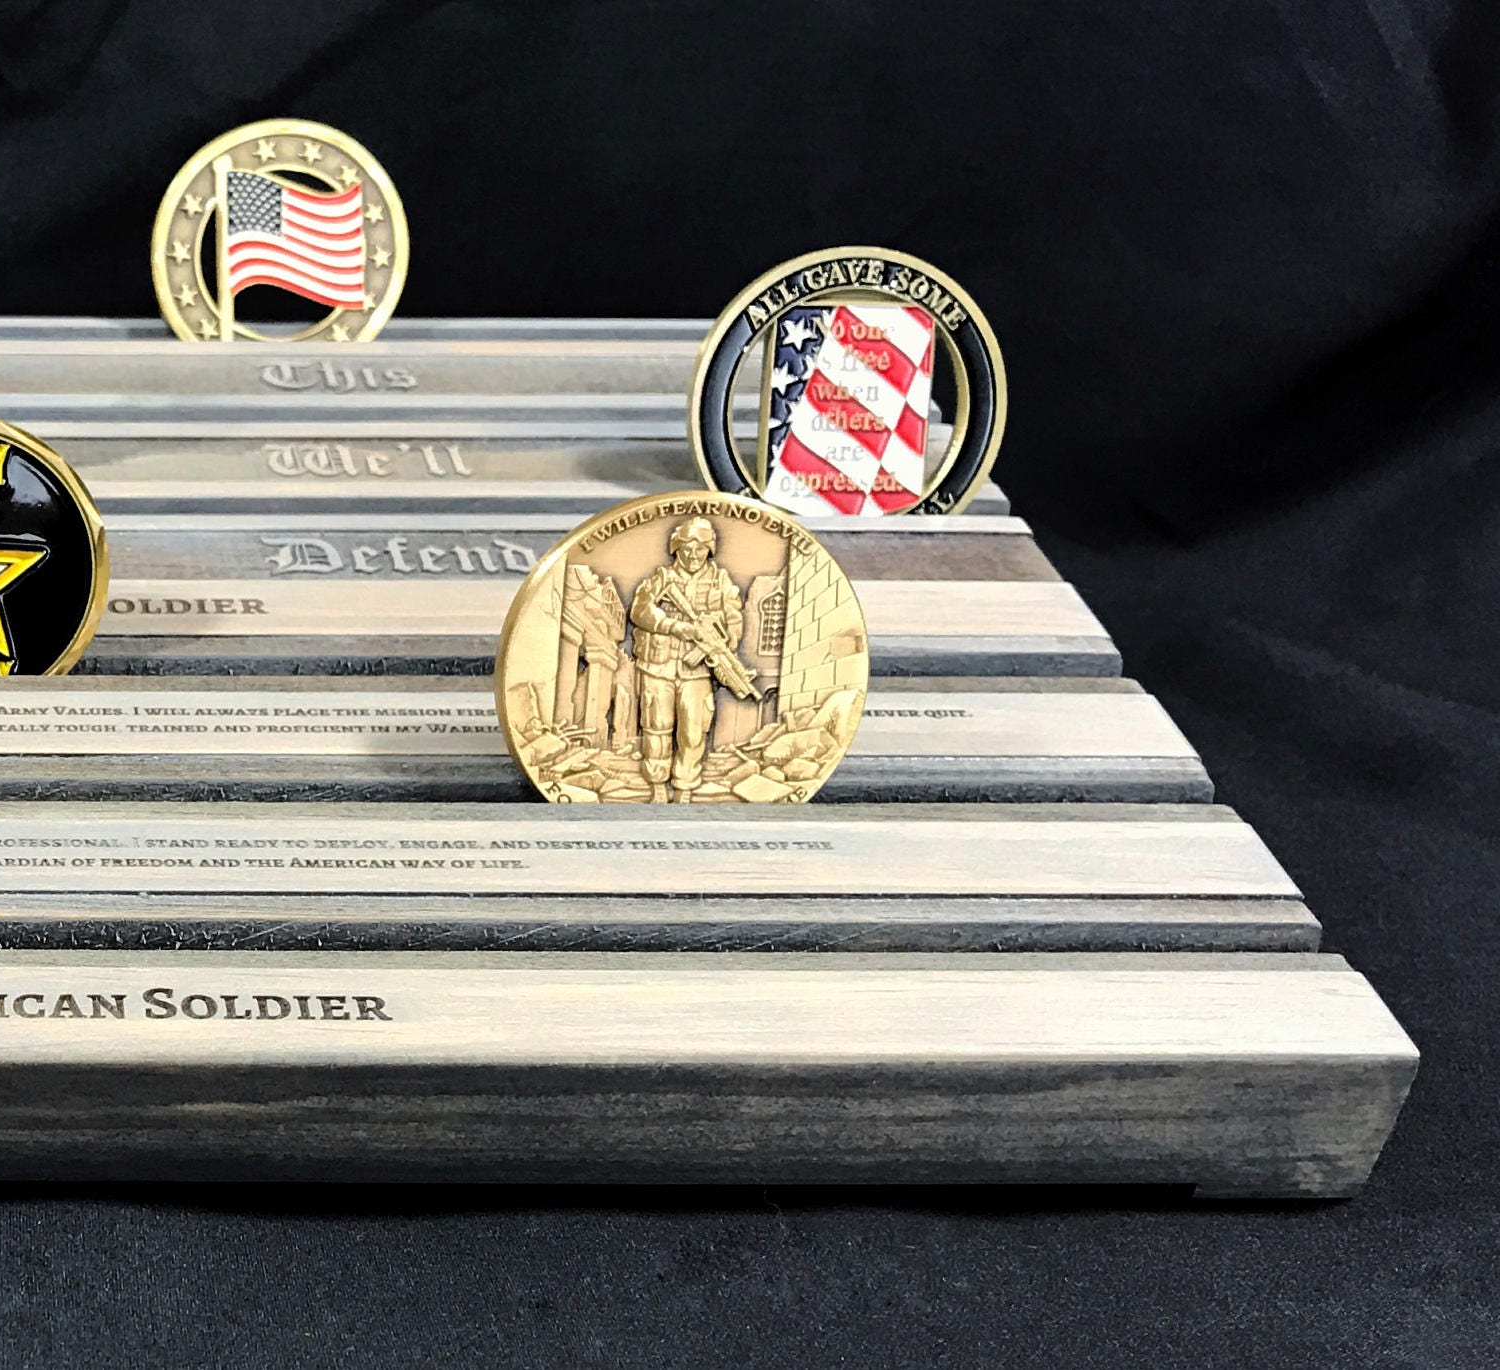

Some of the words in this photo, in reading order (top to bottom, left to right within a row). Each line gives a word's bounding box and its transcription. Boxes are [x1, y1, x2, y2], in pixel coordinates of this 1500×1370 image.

[747, 279, 800, 330] ALL
[805, 259, 884, 290] GAVE
[889, 267, 967, 331] SOME
[840, 345, 891, 372] free
[259, 360, 418, 393] This
[814, 379, 880, 401] when
[811, 404, 885, 432] others
[826, 445, 866, 462] are
[579, 536, 595, 554] I
[593, 508, 655, 542] WILL
[656, 500, 720, 518] FEAR
[726, 501, 761, 524] NO
[762, 513, 815, 556] EVIL
[260, 535, 540, 577] Defend
[107, 598, 270, 614] OLDIER
[144, 706, 190, 714] WILL
[194, 706, 269, 714] ALWAYS
[274, 706, 330, 715] PLACE
[332, 706, 370, 715] THE
[375, 706, 451, 715] MISSION
[457, 707, 497, 715] FIRS
[924, 708, 973, 717] QUIT.
[126, 724, 207, 733] TRAINED
[213, 725, 251, 733] AND
[256, 725, 367, 734] PROFICIENT
[371, 725, 389, 734] IN
[425, 724, 502, 734] WARRIO
[145, 839, 210, 848] STAND
[213, 839, 279, 848] READY
[282, 839, 309, 848] TO
[489, 840, 531, 849] AND
[535, 840, 624, 849] DESTROY
[628, 840, 669, 849] THE
[672, 841, 761, 850] ENEMIES
[765, 841, 790, 850] OF
[792, 841, 834, 850] THE
[71, 858, 96, 867] OF
[100, 858, 194, 867] FREEDOM
[199, 858, 241, 867] AND
[244, 858, 285, 867] THE
[290, 857, 396, 868] AMERICAN
[401, 859, 445, 868] WAY
[450, 859, 476, 868] OF
[480, 859, 530, 868] LIFE.
[141, 987, 394, 1021] SOLDIER
